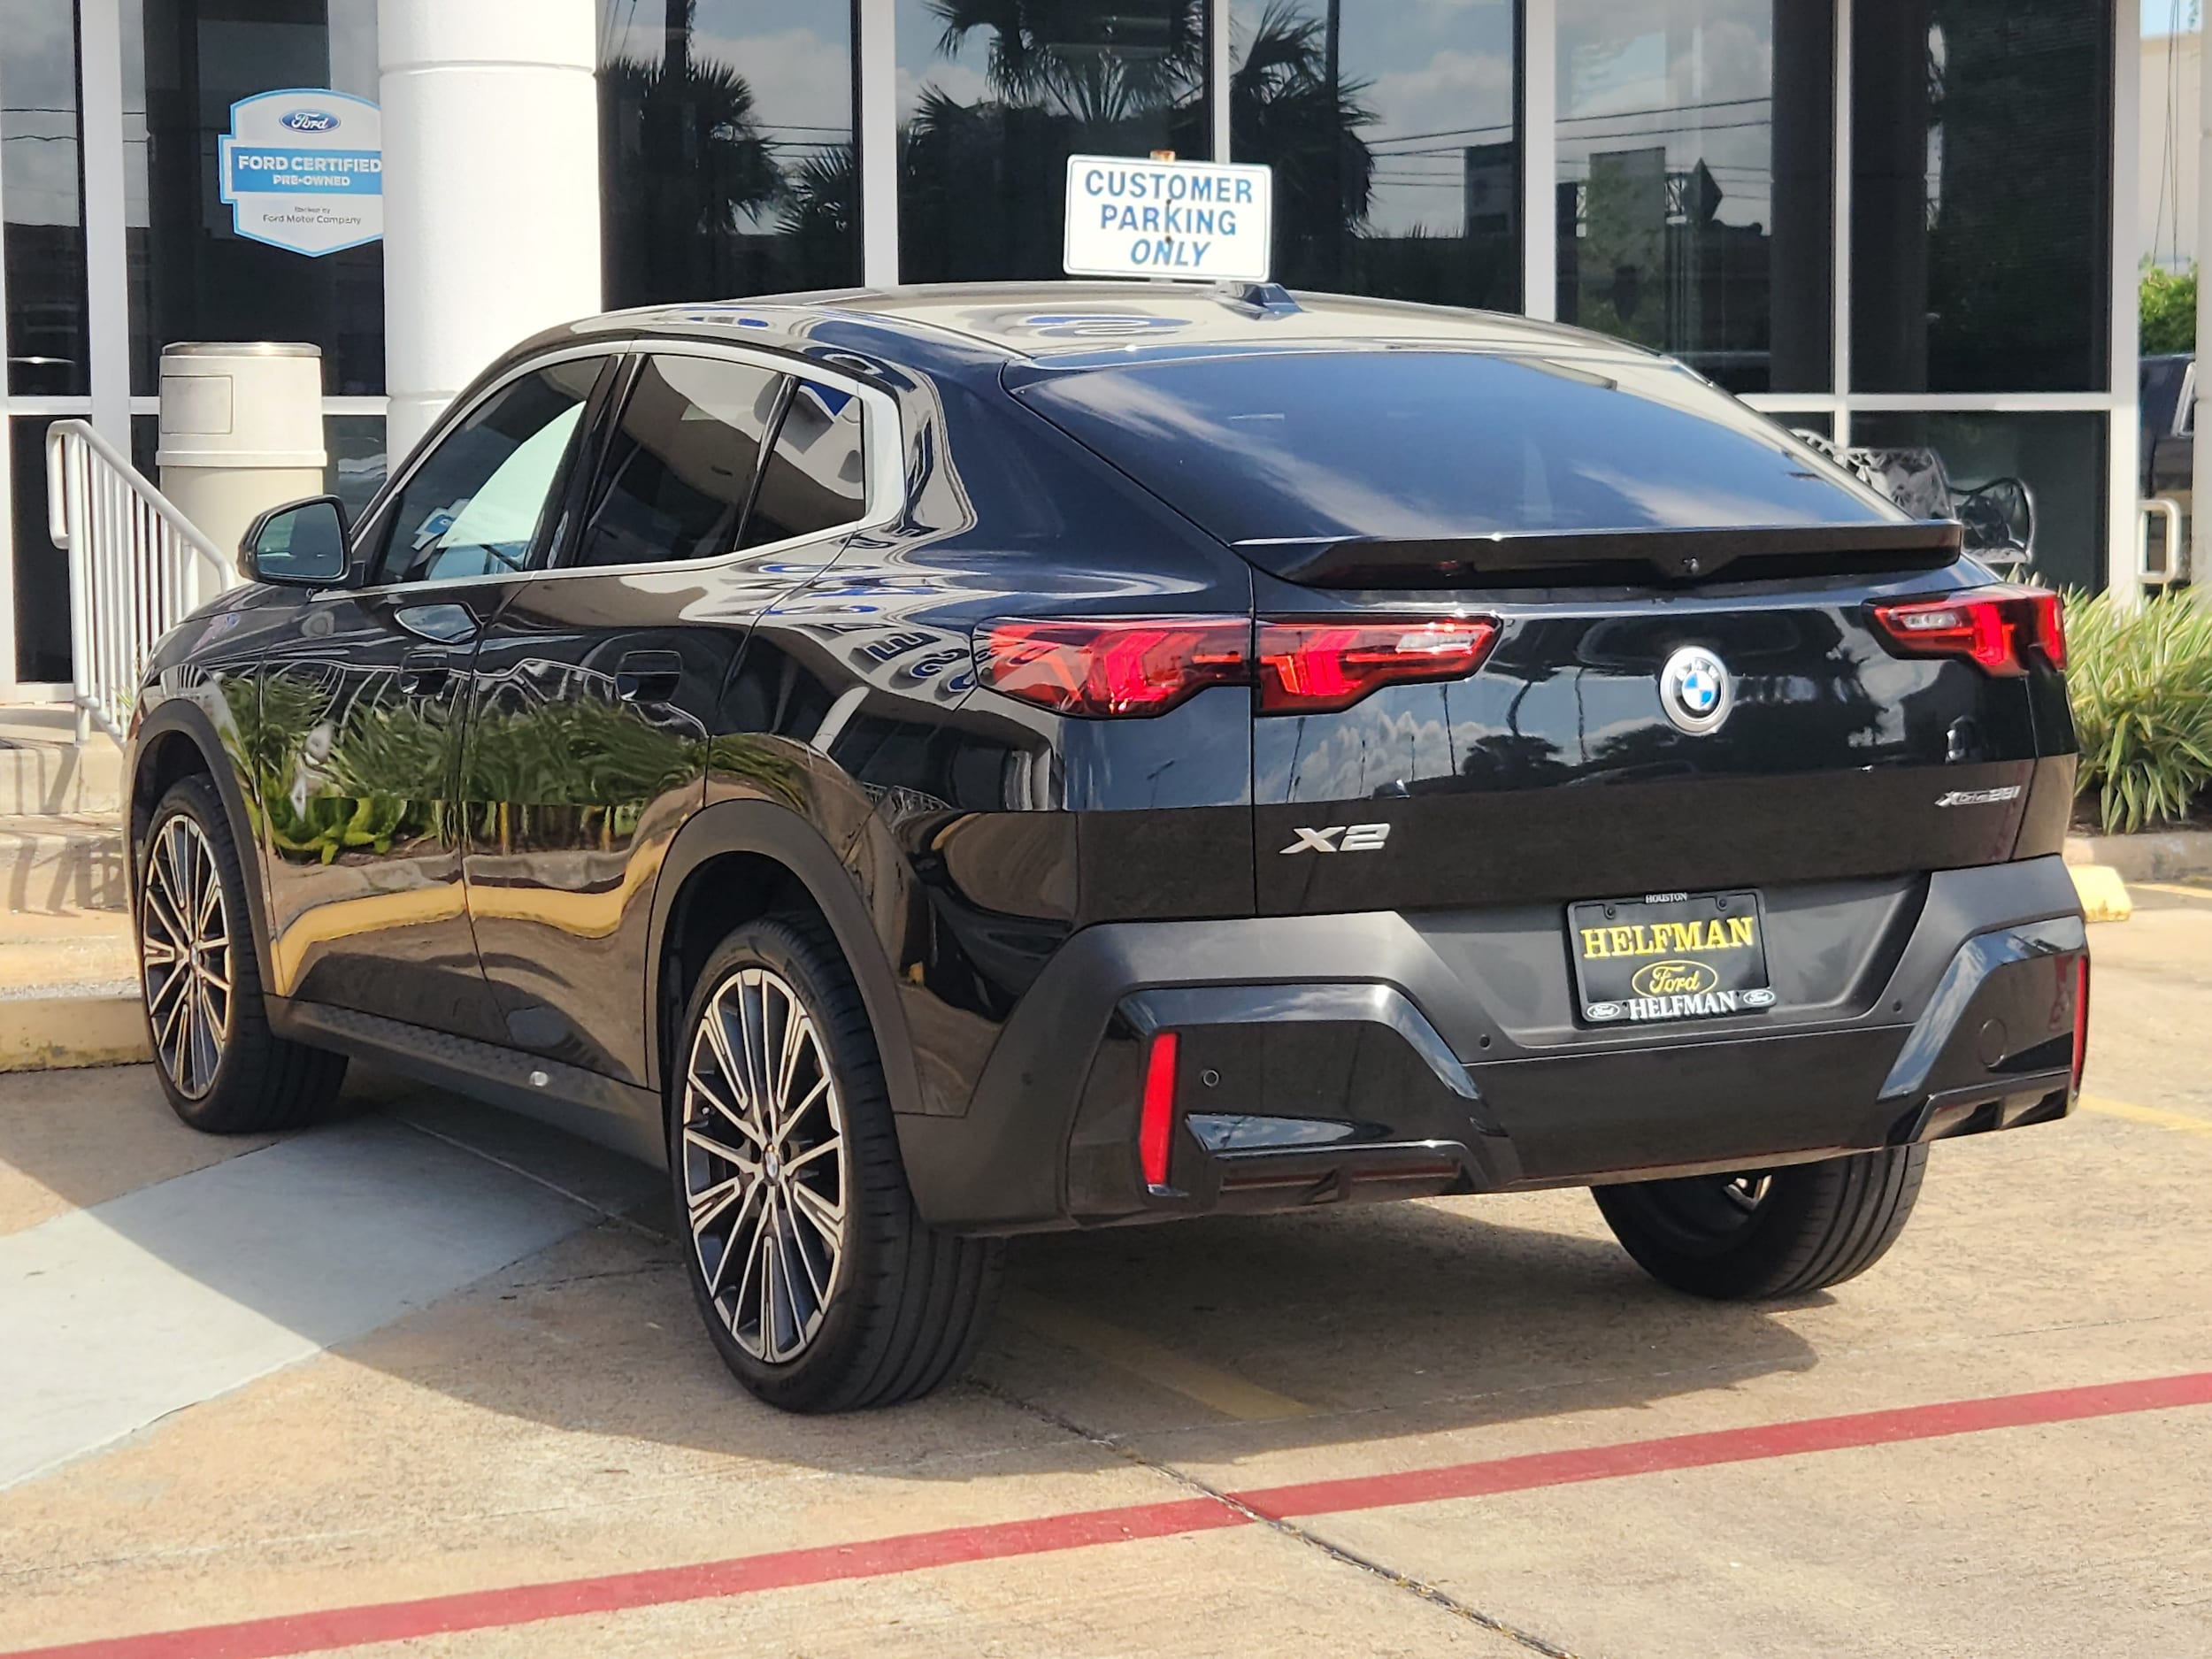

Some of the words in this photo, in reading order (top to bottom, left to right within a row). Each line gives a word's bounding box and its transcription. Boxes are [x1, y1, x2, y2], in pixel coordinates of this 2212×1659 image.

[289, 111, 331, 131] Ford
[238, 155, 288, 171] FORD
[290, 156, 382, 173] CERTIFIED
[273, 173, 351, 187] PRE-OWNED
[1085, 169, 1253, 204] CUSTOMER
[263, 214, 284, 223] Ford
[287, 214, 315, 224] Motor
[317, 215, 362, 225] Company
[1100, 203, 1237, 236] PARKING
[1130, 238, 1212, 266] ONLY
[1279, 823, 1391, 854] X2
[1645, 892, 1688, 904] HOUSTON
[1580, 916, 1754, 958] HELFMAN
[1648, 965, 1701, 994] Ford
[1627, 989, 1738, 1020] HELFMAN
